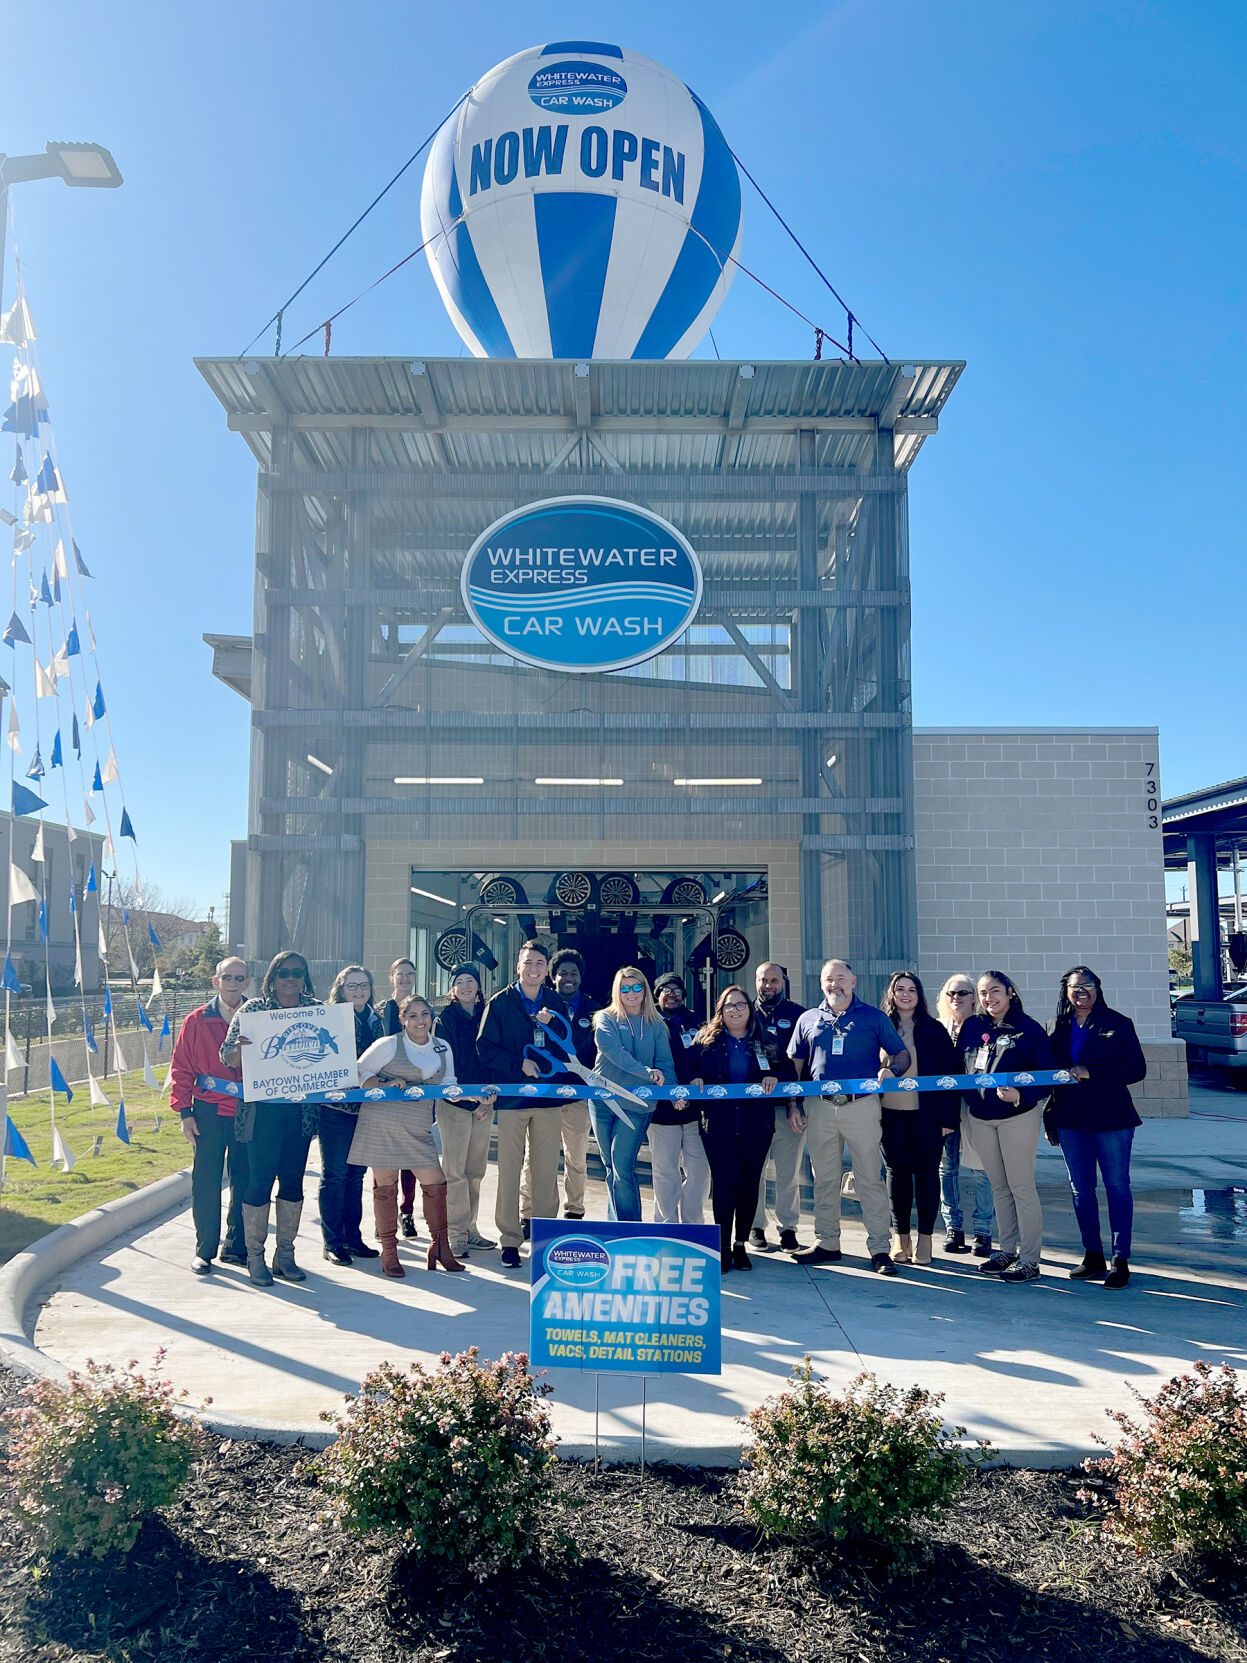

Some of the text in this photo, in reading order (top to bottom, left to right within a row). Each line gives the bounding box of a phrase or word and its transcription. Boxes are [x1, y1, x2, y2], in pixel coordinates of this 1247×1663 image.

[536, 72, 621, 84] WHITEWATER
[536, 79, 580, 87] EXPRESS
[541, 96, 613, 108] CAR WASH
[470, 125, 685, 206] NOW OPEN
[487, 548, 678, 567] WHITEWATER
[490, 569, 588, 584] EXPRESS
[503, 616, 663, 636] CAR WASH
[1145, 762, 1158, 829] 7303
[269, 1007, 326, 1021] Welcome To
[253, 1069, 349, 1090] BAYTOWN CHAMBER
[265, 1087, 279, 1097] OF
[281, 1079, 339, 1095] COMMERCE
[553, 1250, 606, 1259] WHITEWATER
[612, 1255, 706, 1292] FREE
[543, 1291, 709, 1326] AMENITIES
[545, 1328, 707, 1350] TOWELS, MAT CLEANERS,
[549, 1343, 703, 1364] VACS, DETAIL STATIONS
